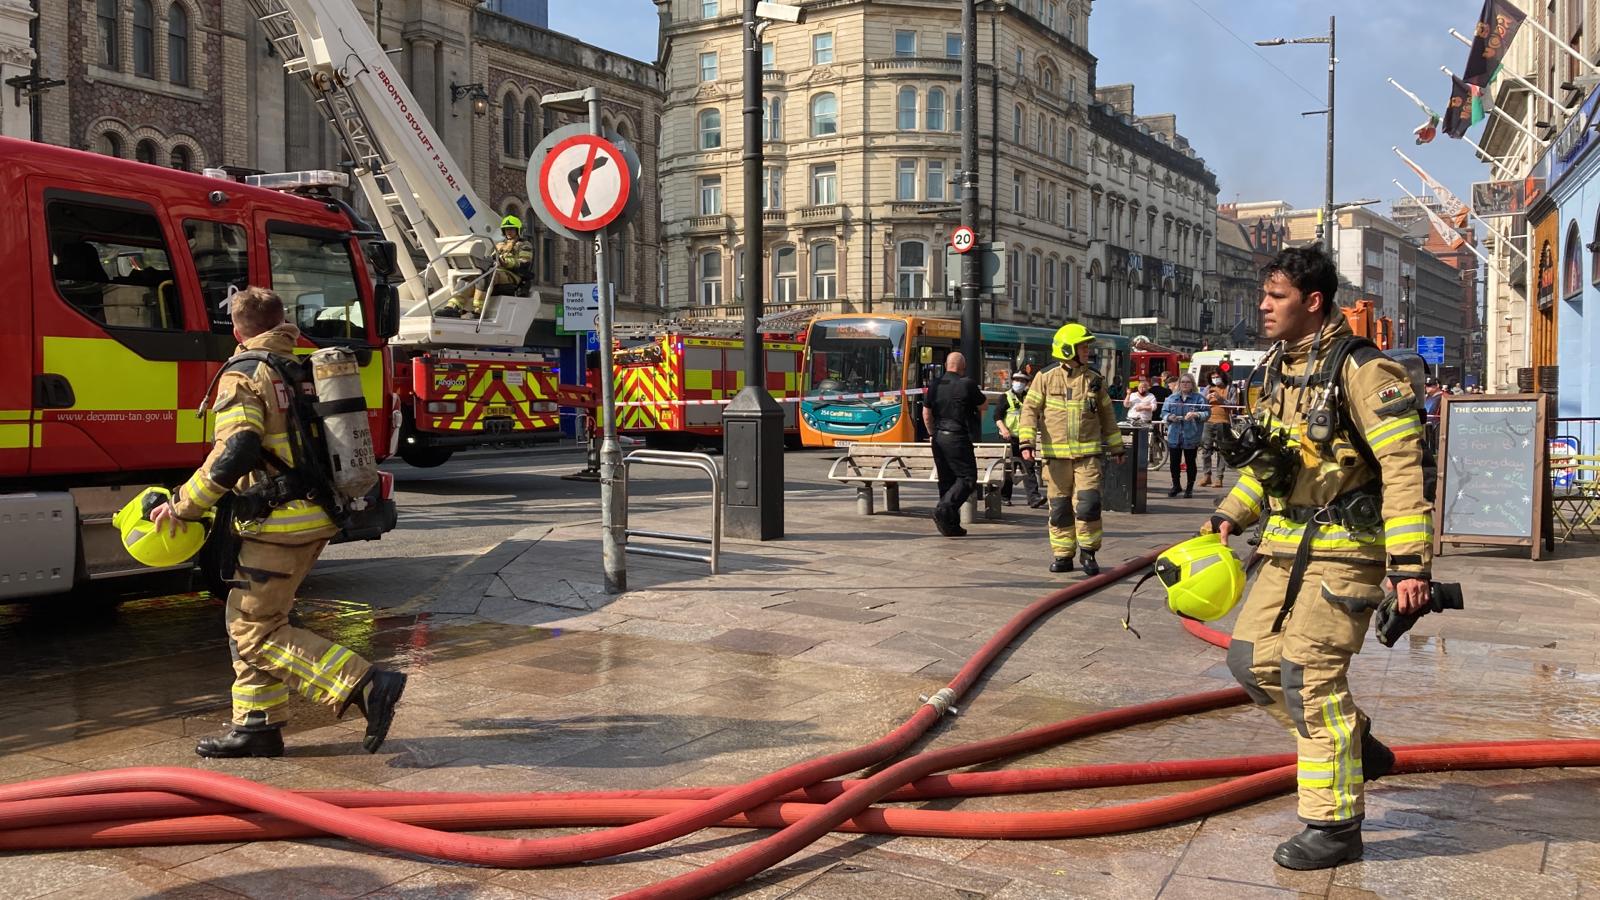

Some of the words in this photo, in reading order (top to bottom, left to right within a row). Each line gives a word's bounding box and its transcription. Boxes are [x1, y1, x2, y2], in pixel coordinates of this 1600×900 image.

[377, 70, 408, 113] BRONTO
[405, 112, 434, 151] SKYLIFT
[437, 161, 448, 176] 32
[955, 233, 970, 245] 20
[57, 411, 173, 422] www.decymru-tan.gov.uk
